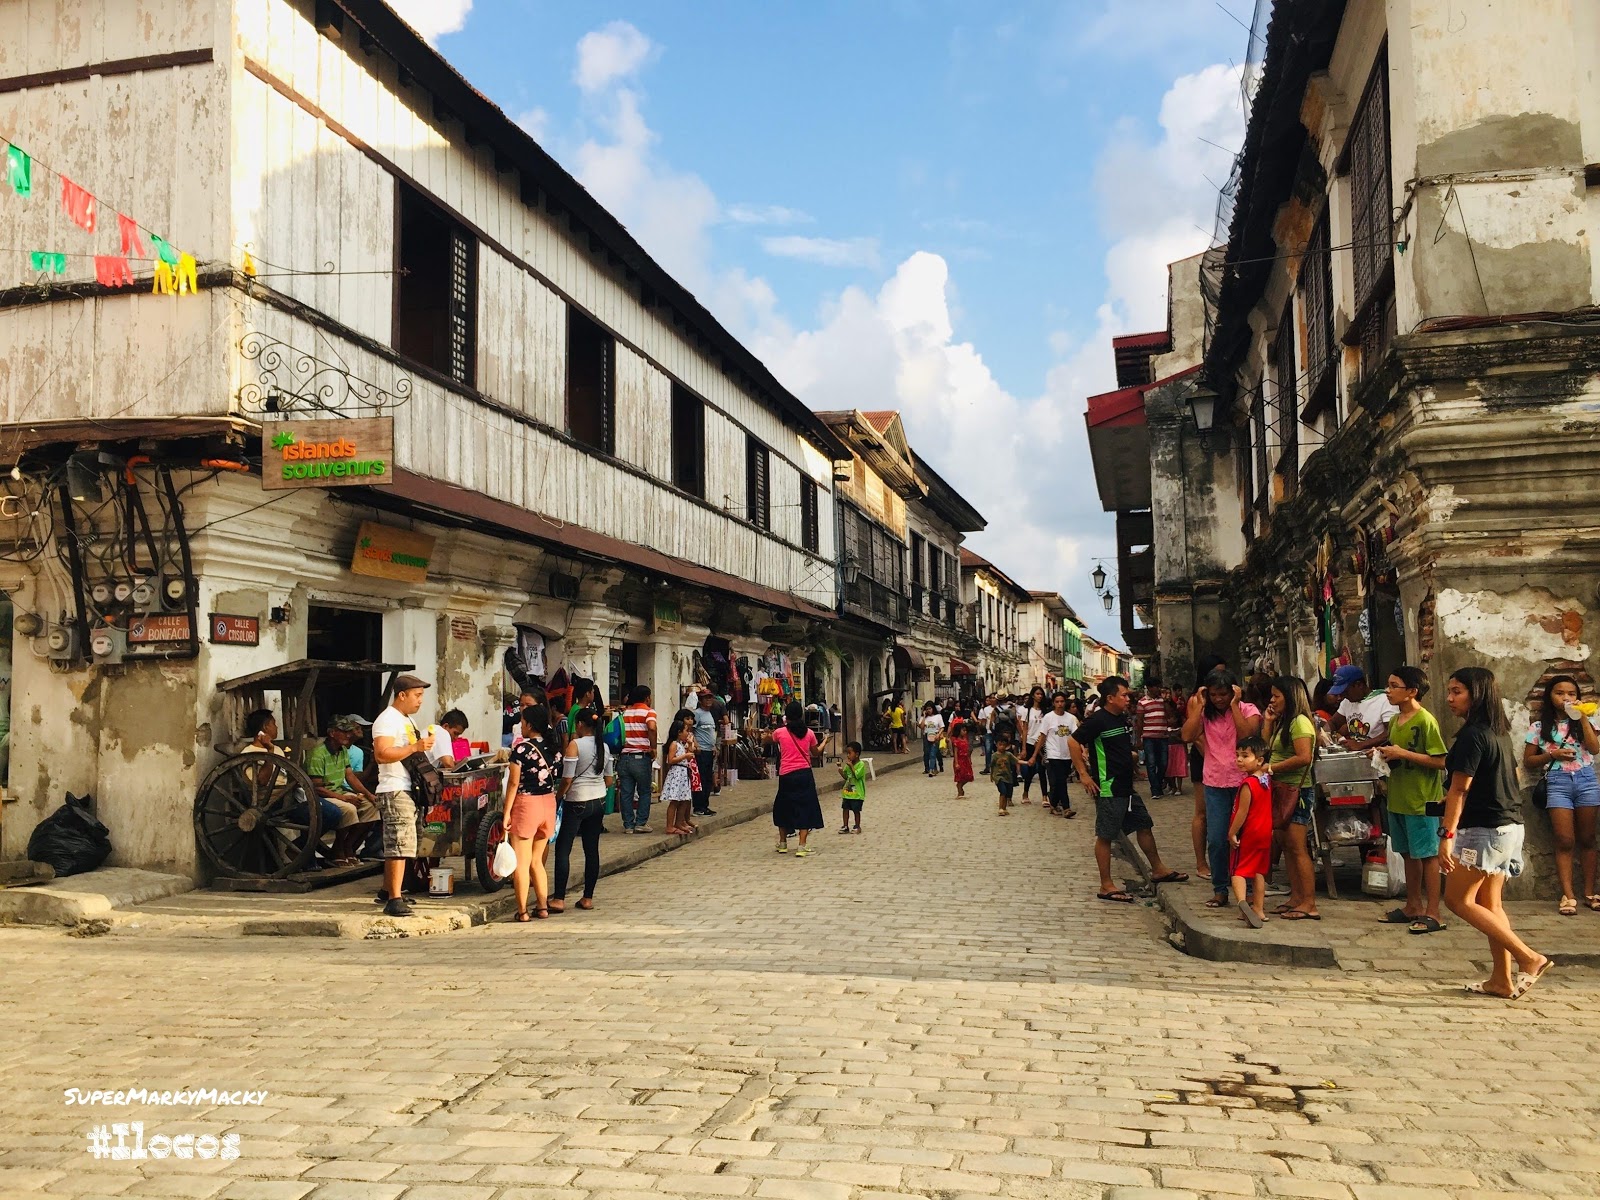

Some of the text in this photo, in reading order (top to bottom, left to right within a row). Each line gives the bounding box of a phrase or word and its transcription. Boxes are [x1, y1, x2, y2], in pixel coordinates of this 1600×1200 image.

[282, 437, 357, 461] islands
[282, 459, 386, 480] souvenirs
[158, 616, 181, 626] CALLE
[234, 619, 250, 629] CALLE
[147, 627, 190, 641] BONIFACIO
[228, 629, 256, 642] CRISOLOGO
